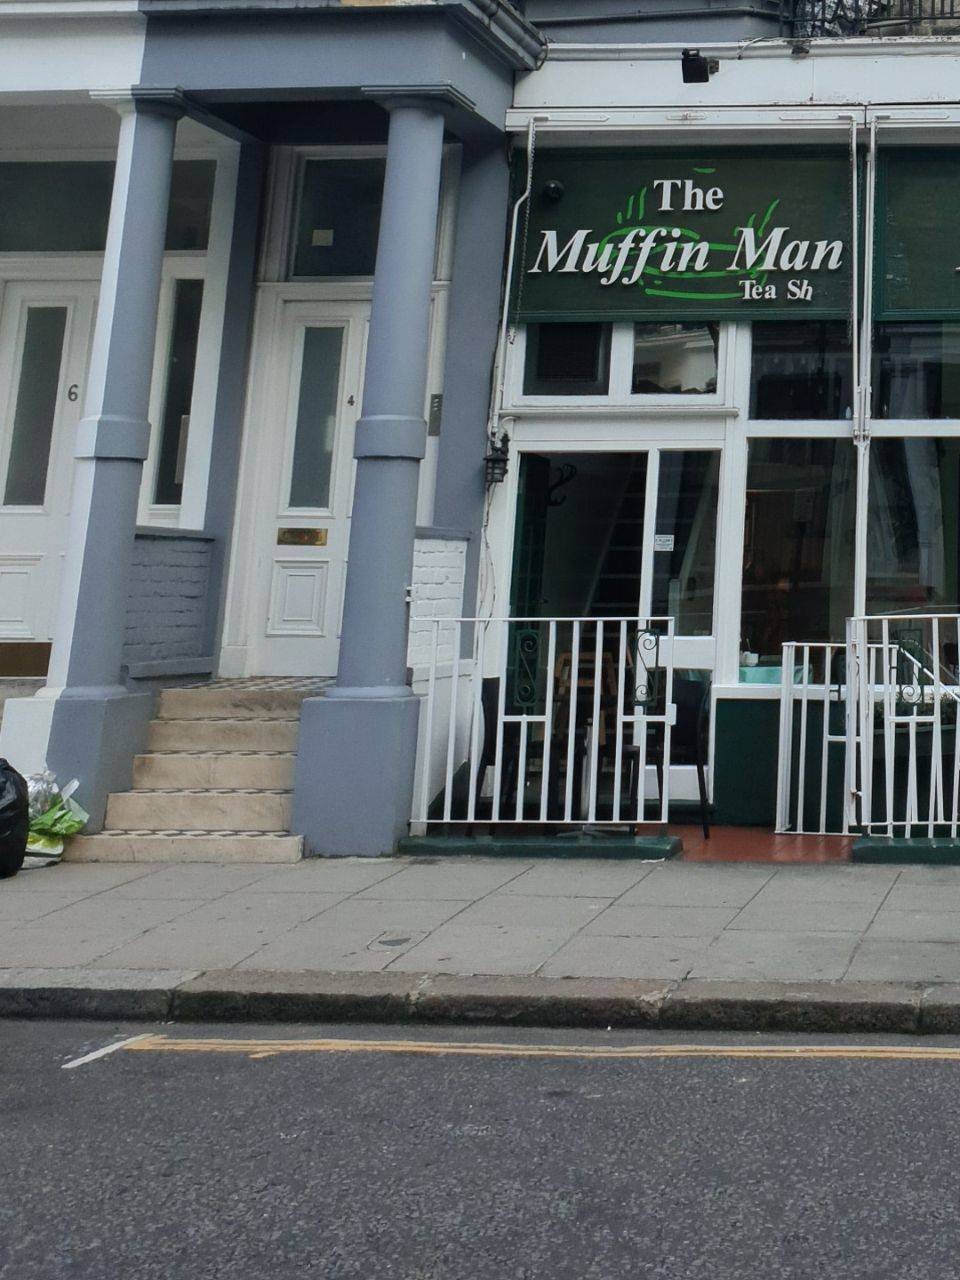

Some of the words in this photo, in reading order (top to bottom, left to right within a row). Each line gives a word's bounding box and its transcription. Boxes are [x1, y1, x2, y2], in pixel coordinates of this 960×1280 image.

[653, 179, 724, 212] The
[528, 228, 710, 286] Muffin
[726, 227, 844, 271] Man
[739, 279, 777, 300] Tea
[787, 279, 813, 301] Sh
[67, 383, 79, 402] 6
[347, 394, 355, 406] 4
